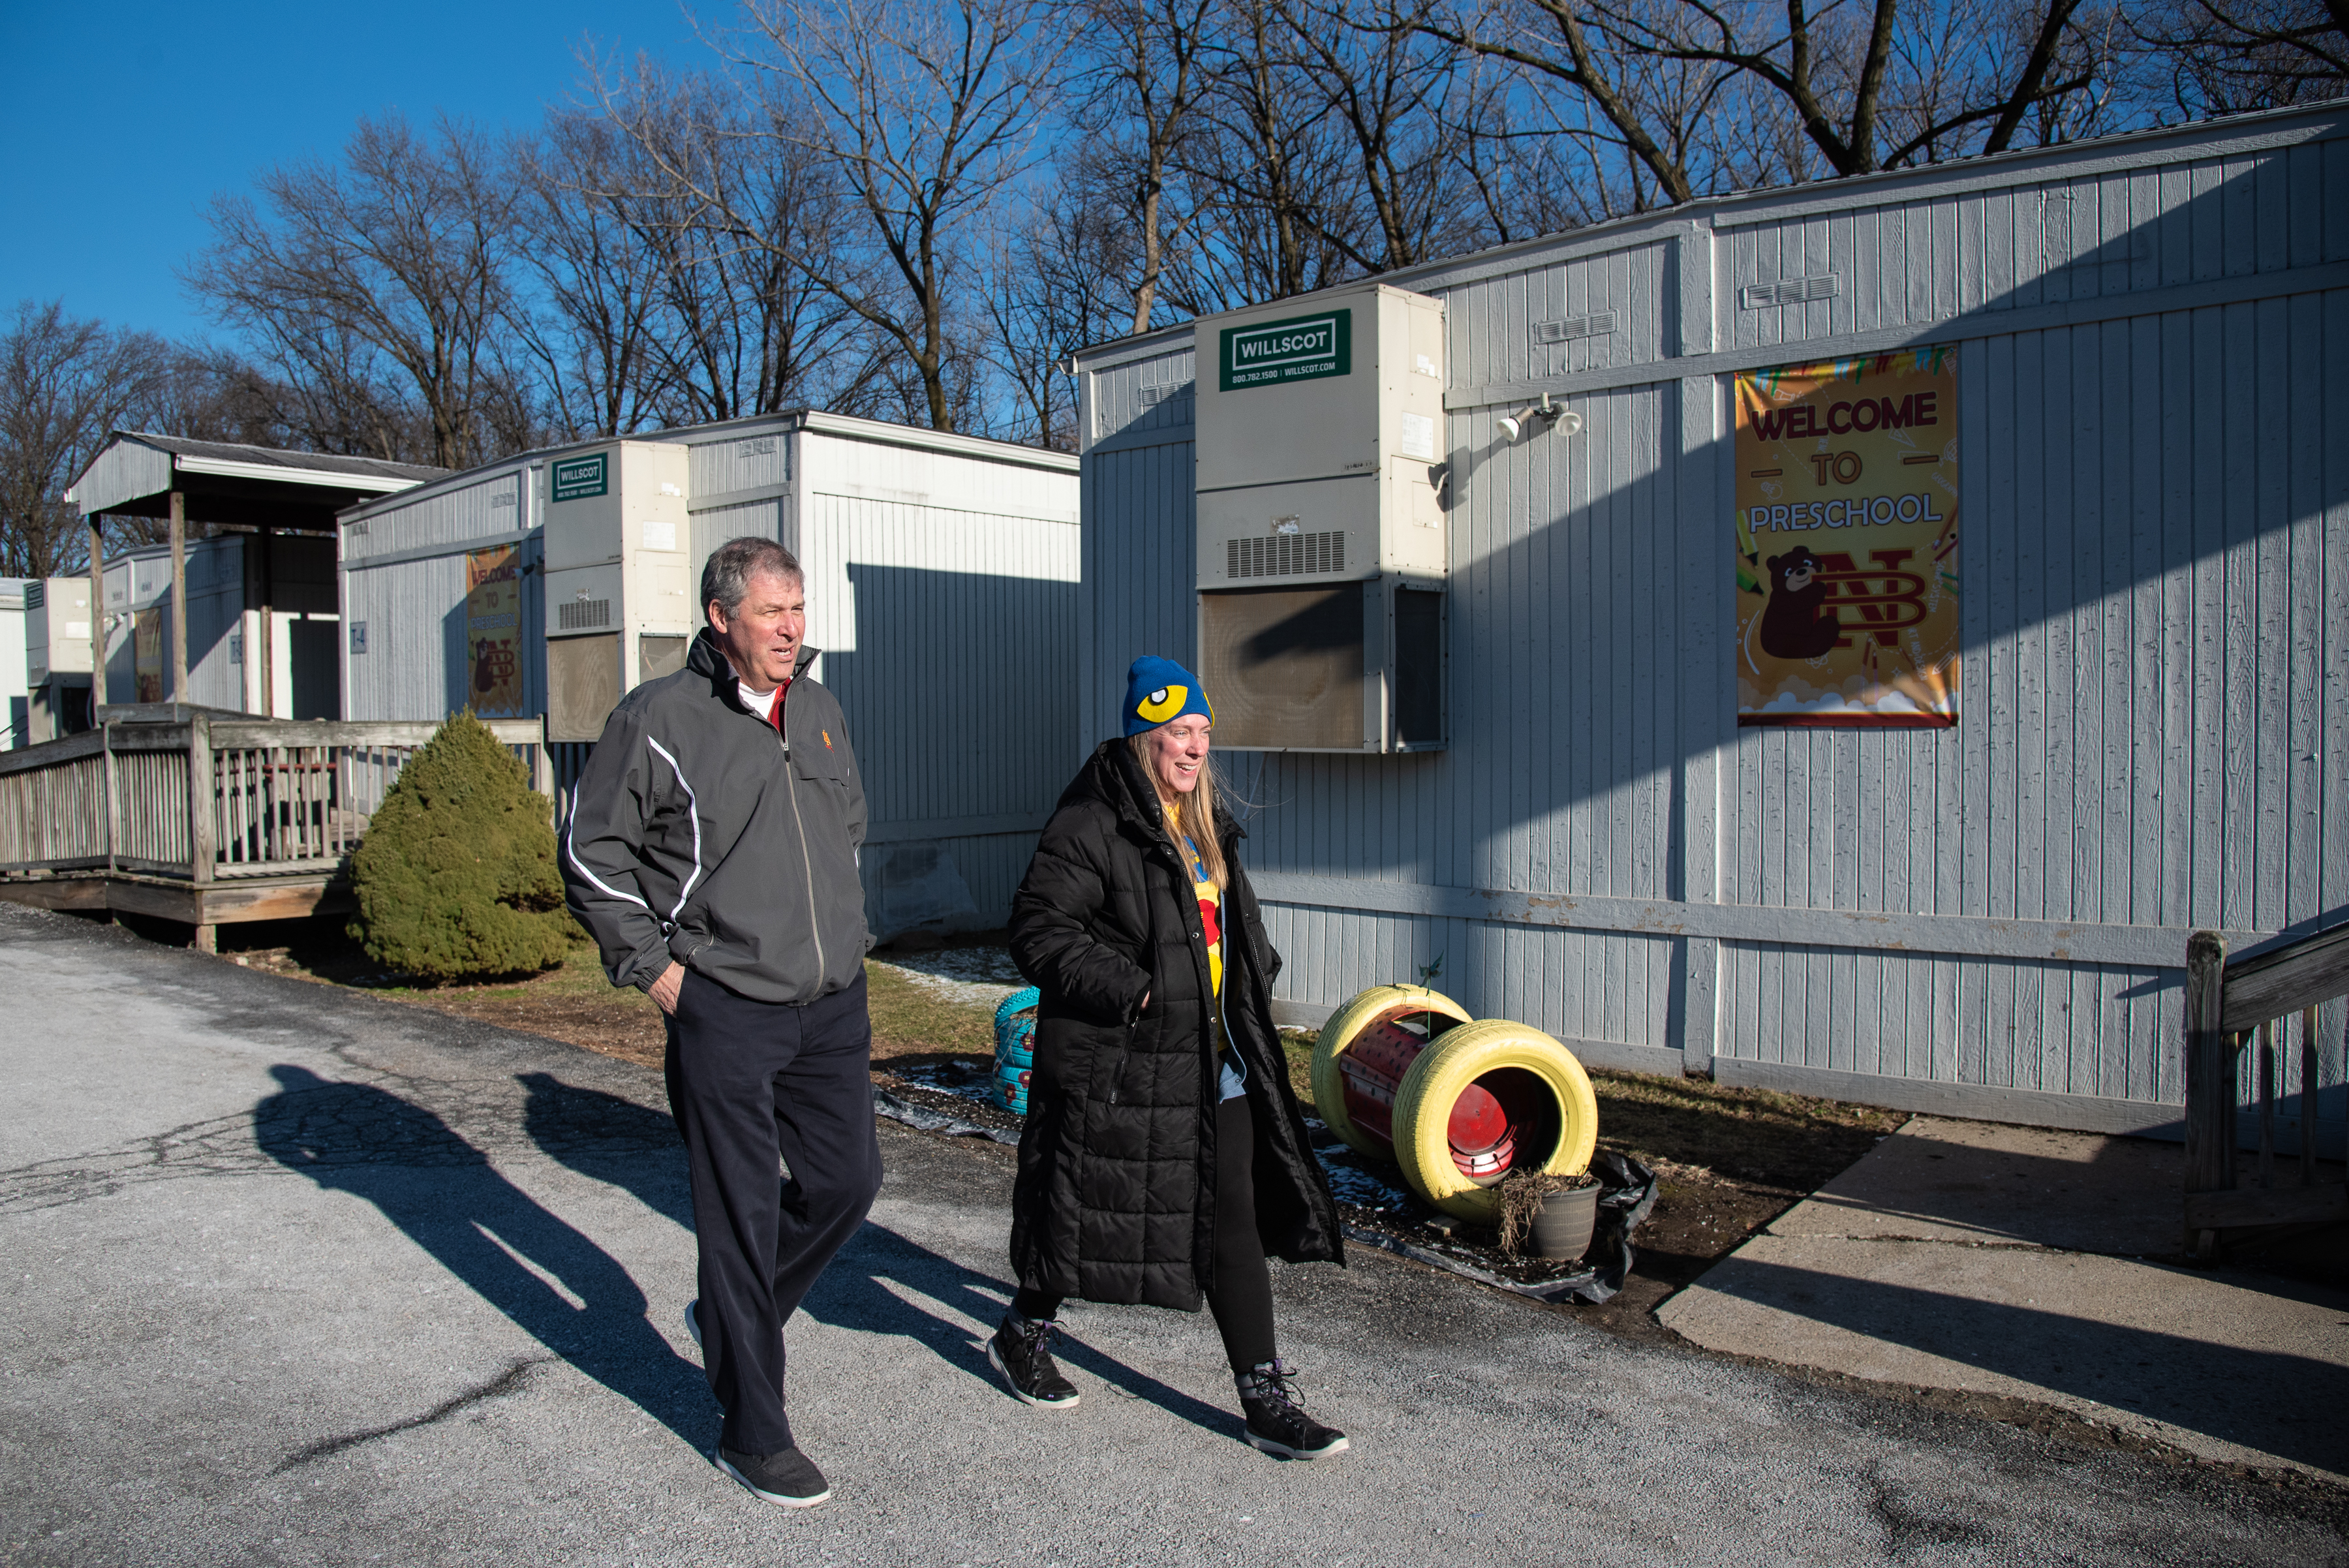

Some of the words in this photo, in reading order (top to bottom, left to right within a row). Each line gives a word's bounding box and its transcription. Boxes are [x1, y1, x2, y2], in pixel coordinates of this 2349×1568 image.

[1241, 331, 1327, 358] WILLSCOT
[1232, 370, 1278, 384] 800.782.1500
[1284, 361, 1336, 377] WILLSCOT.COM
[1751, 392, 1938, 442] WELCOME
[561, 466, 598, 482] WILLSCOT
[1811, 451, 1862, 486] TO
[1750, 493, 1942, 533] PRESCHOOL
[472, 564, 517, 586] WELCOME
[485, 591, 499, 609] TO
[470, 613, 517, 631] PRESCHOOL
[351, 628, 365, 647] T-4
